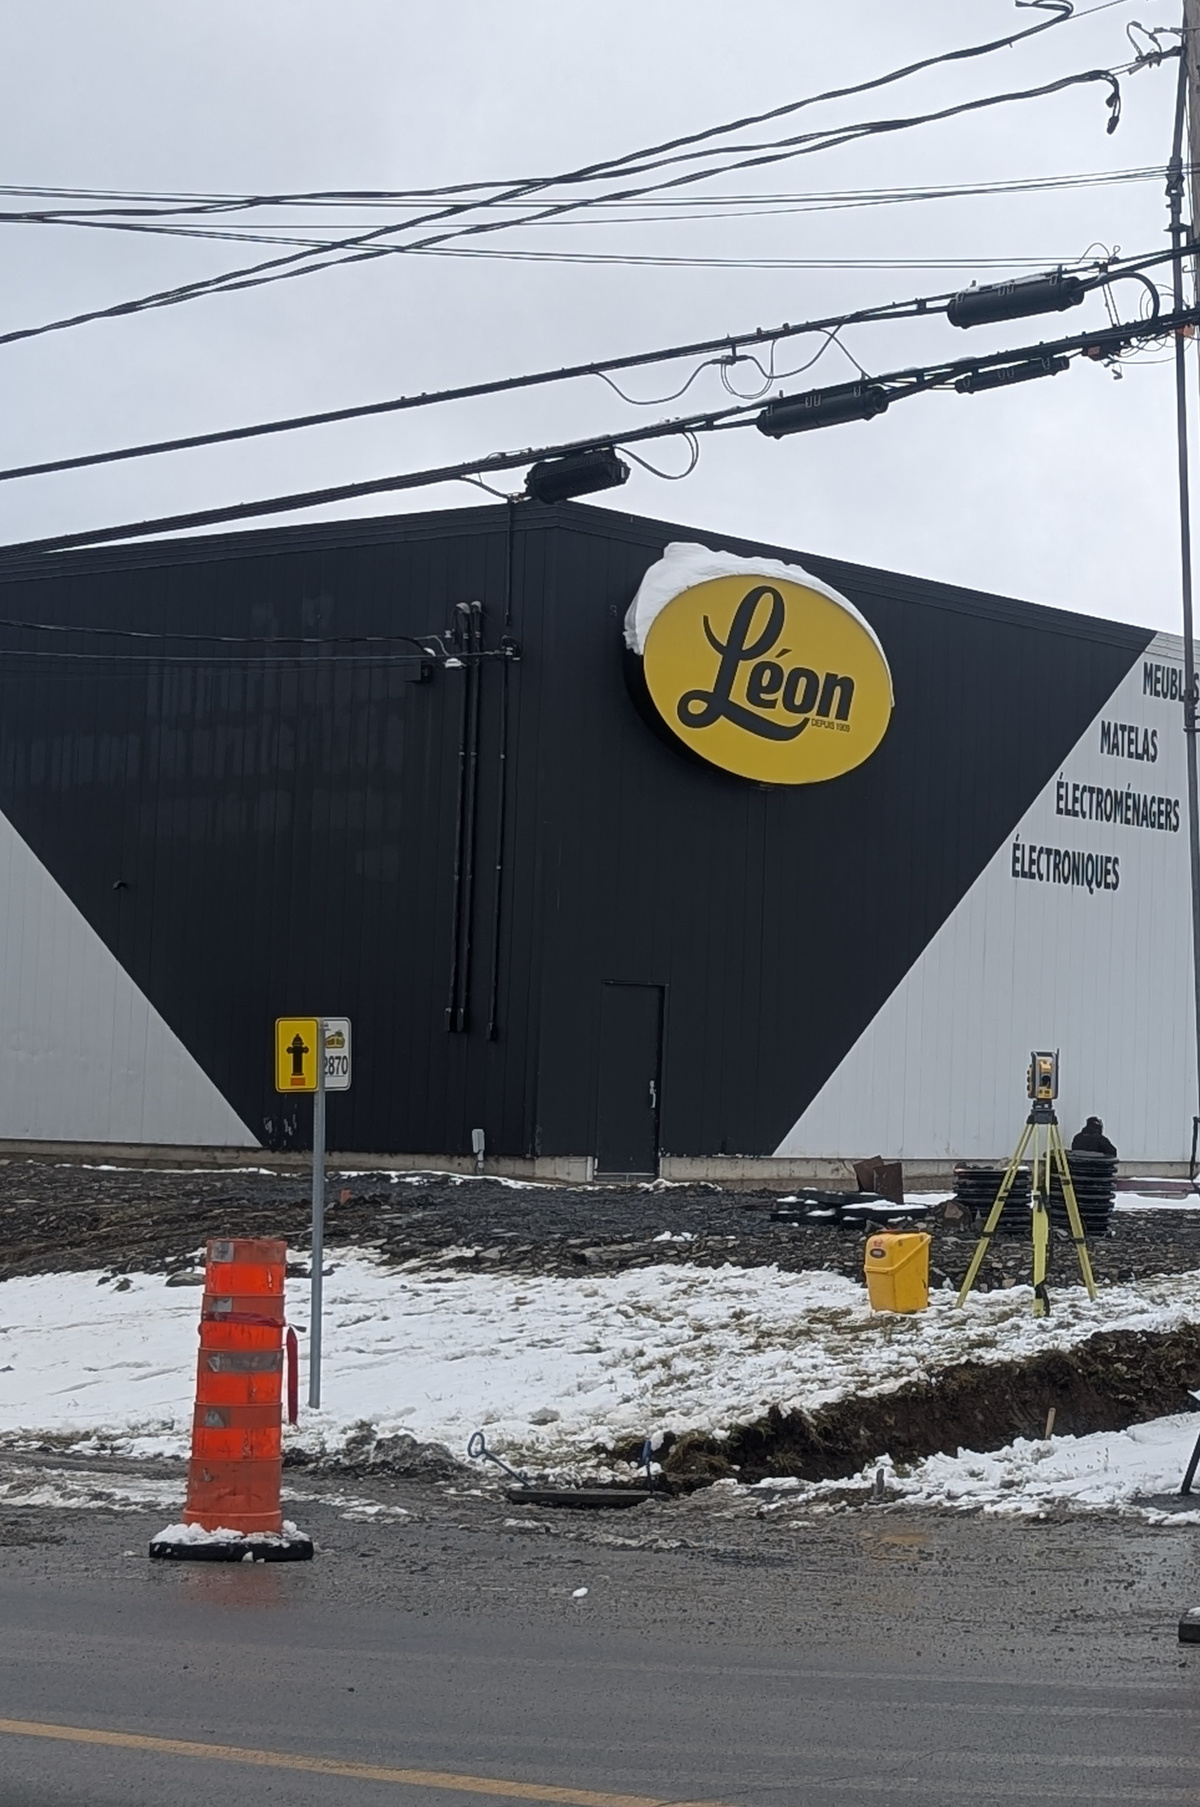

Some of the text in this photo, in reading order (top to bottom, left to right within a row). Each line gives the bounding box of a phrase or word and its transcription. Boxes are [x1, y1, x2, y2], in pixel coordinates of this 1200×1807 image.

[677, 585, 855, 742] Léon
[1143, 661, 1200, 706] MEUBLS
[1100, 720, 1158, 763] MATELAS
[1055, 772, 1180, 833] ÉLECTROMÉNAGERS
[1011, 833, 1120, 895] ÉLECTRONIQUES
